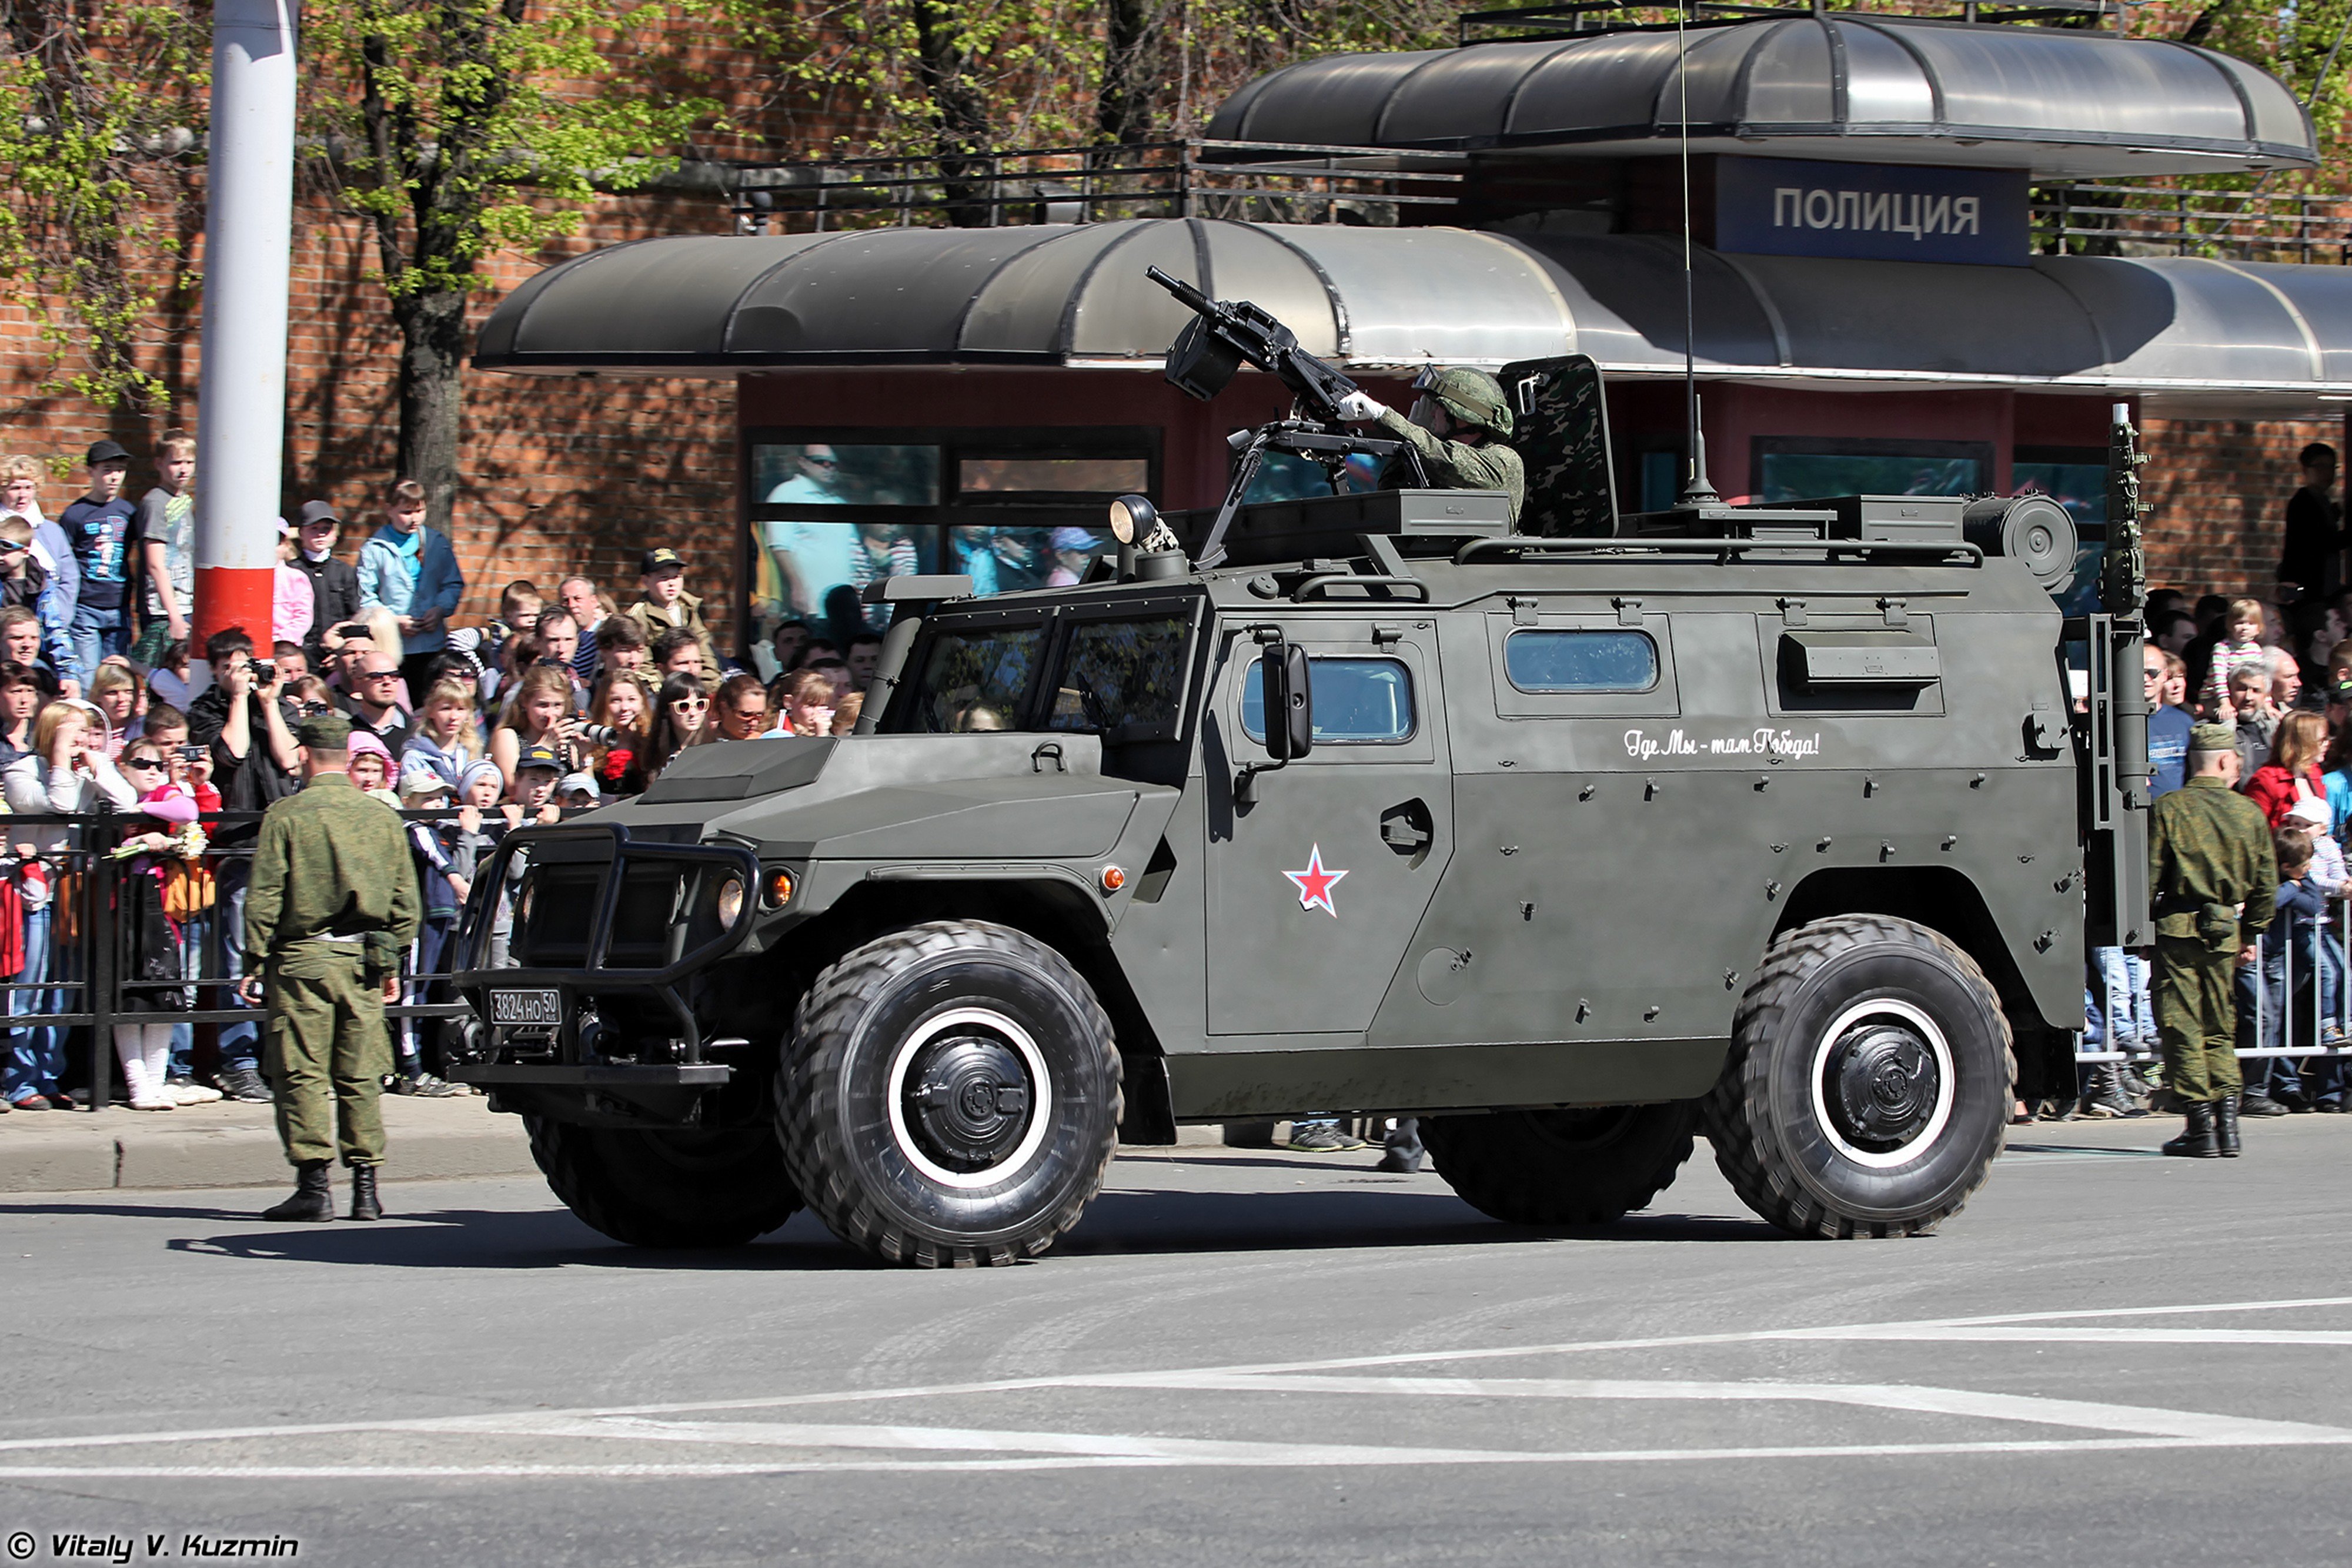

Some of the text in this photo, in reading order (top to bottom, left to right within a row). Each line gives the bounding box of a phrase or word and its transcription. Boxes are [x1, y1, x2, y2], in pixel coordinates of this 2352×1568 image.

[1774, 187, 1979, 241] ПОЛИЦИЯ
[1624, 730, 1660, 760] Где
[1661, 729, 1698, 755] Мы
[1711, 738, 1752, 754] там
[1753, 728, 1820, 760] Победа!
[543, 992, 556, 1012] 50
